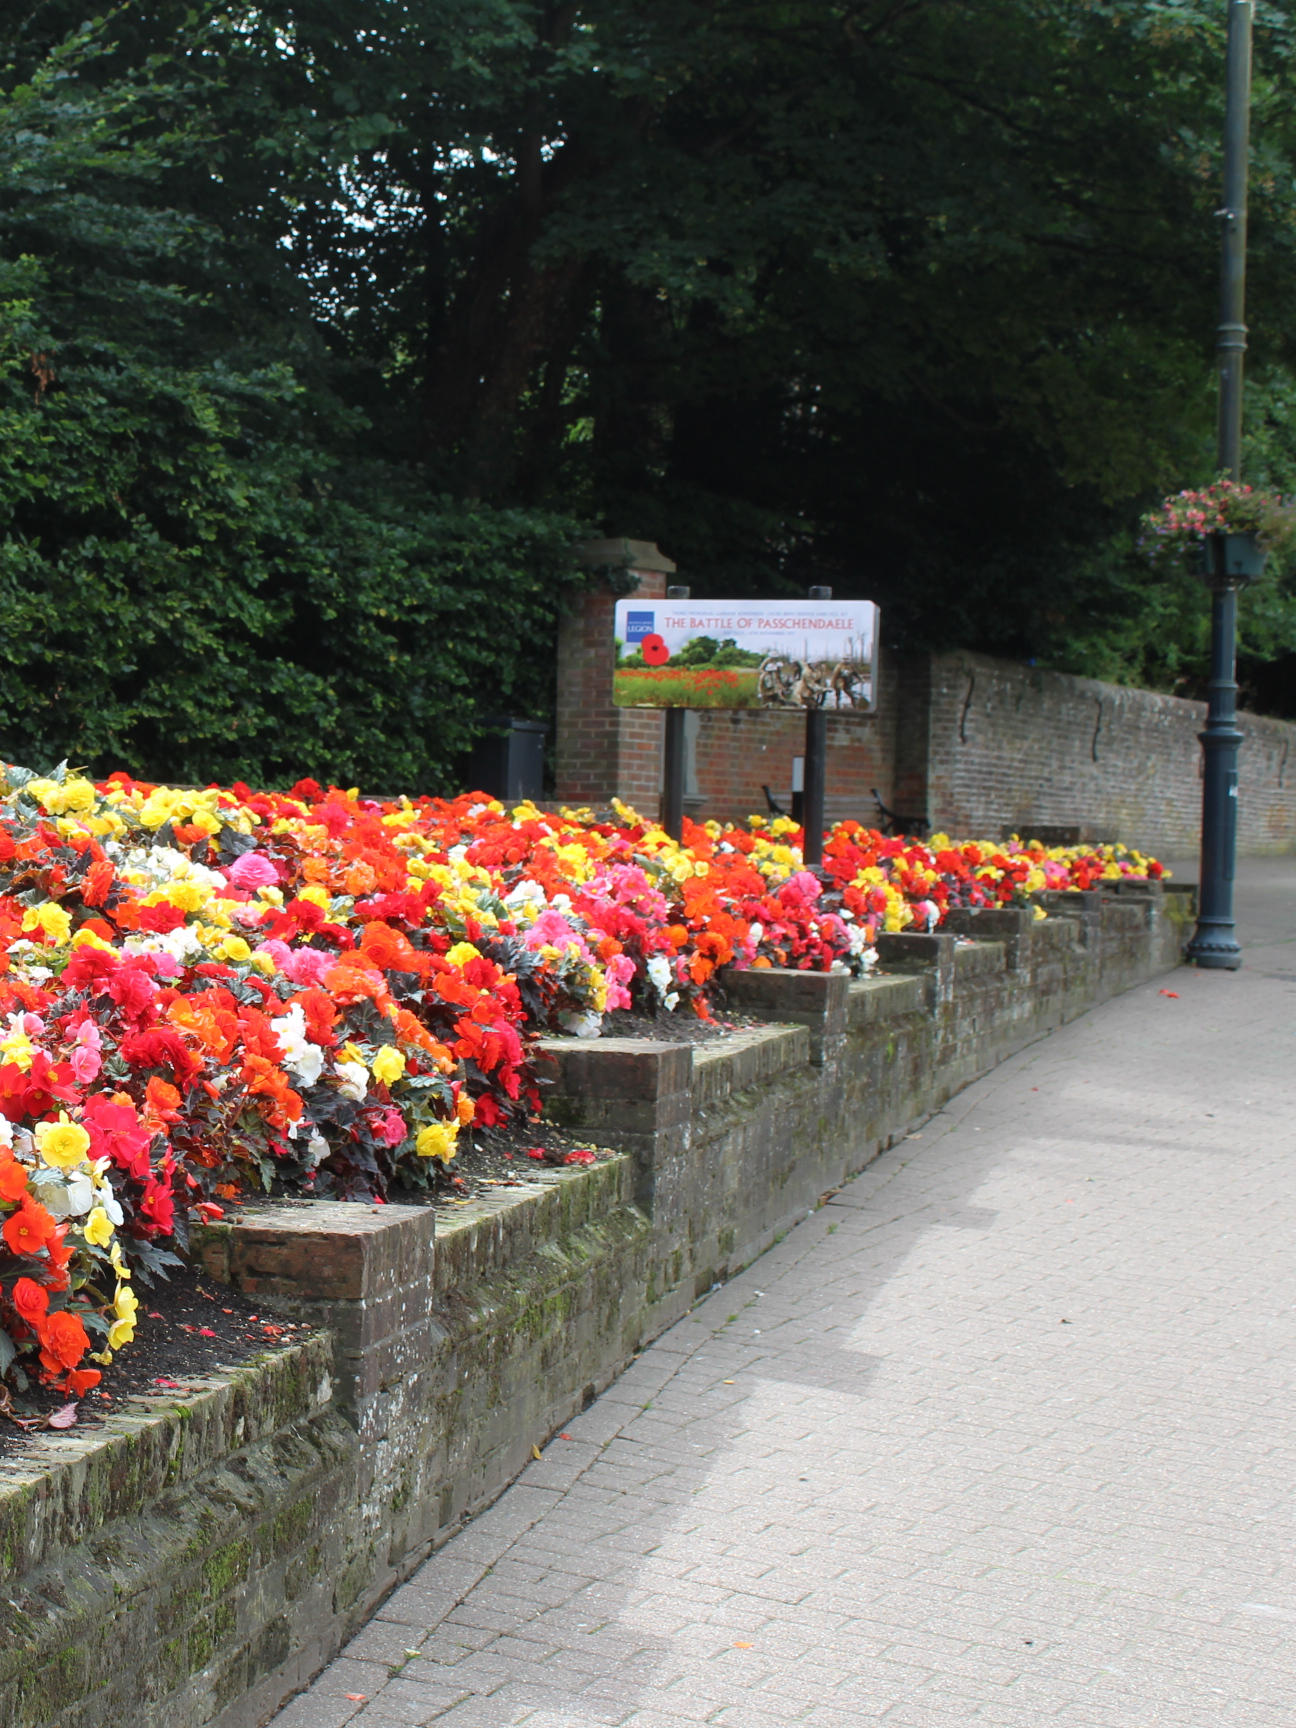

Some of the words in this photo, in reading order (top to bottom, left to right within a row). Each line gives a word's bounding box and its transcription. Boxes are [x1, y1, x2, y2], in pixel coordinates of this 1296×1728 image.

[664, 617, 686, 629] THE
[689, 617, 733, 629] BATTLE
[737, 617, 754, 629] OF
[757, 617, 854, 630] PASSCHENDAELE
[627, 625, 653, 633] LEGION
